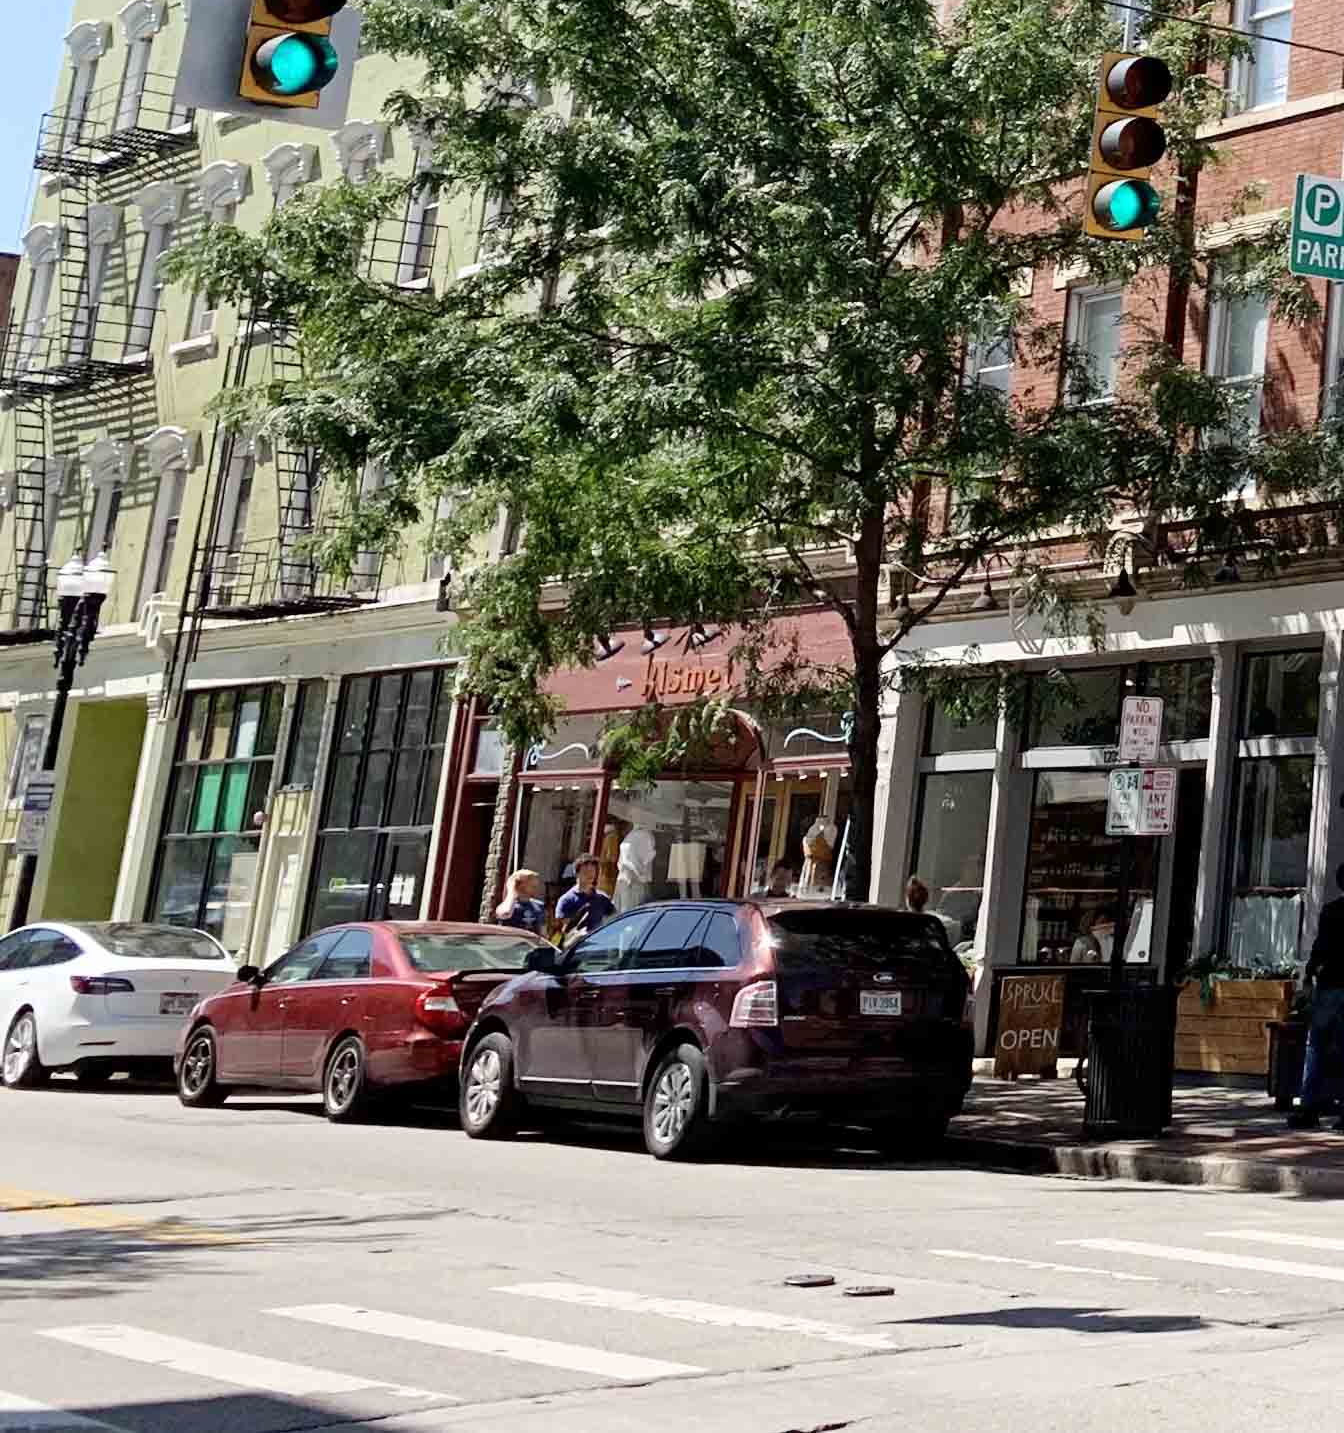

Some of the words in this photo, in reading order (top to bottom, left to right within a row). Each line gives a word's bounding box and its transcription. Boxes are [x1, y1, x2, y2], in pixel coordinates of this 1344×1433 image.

[1314, 187, 1336, 223] P
[1136, 701, 1150, 713] NO
[1148, 792, 1166, 804] ANY
[1000, 1028, 1058, 1050] OPEN
